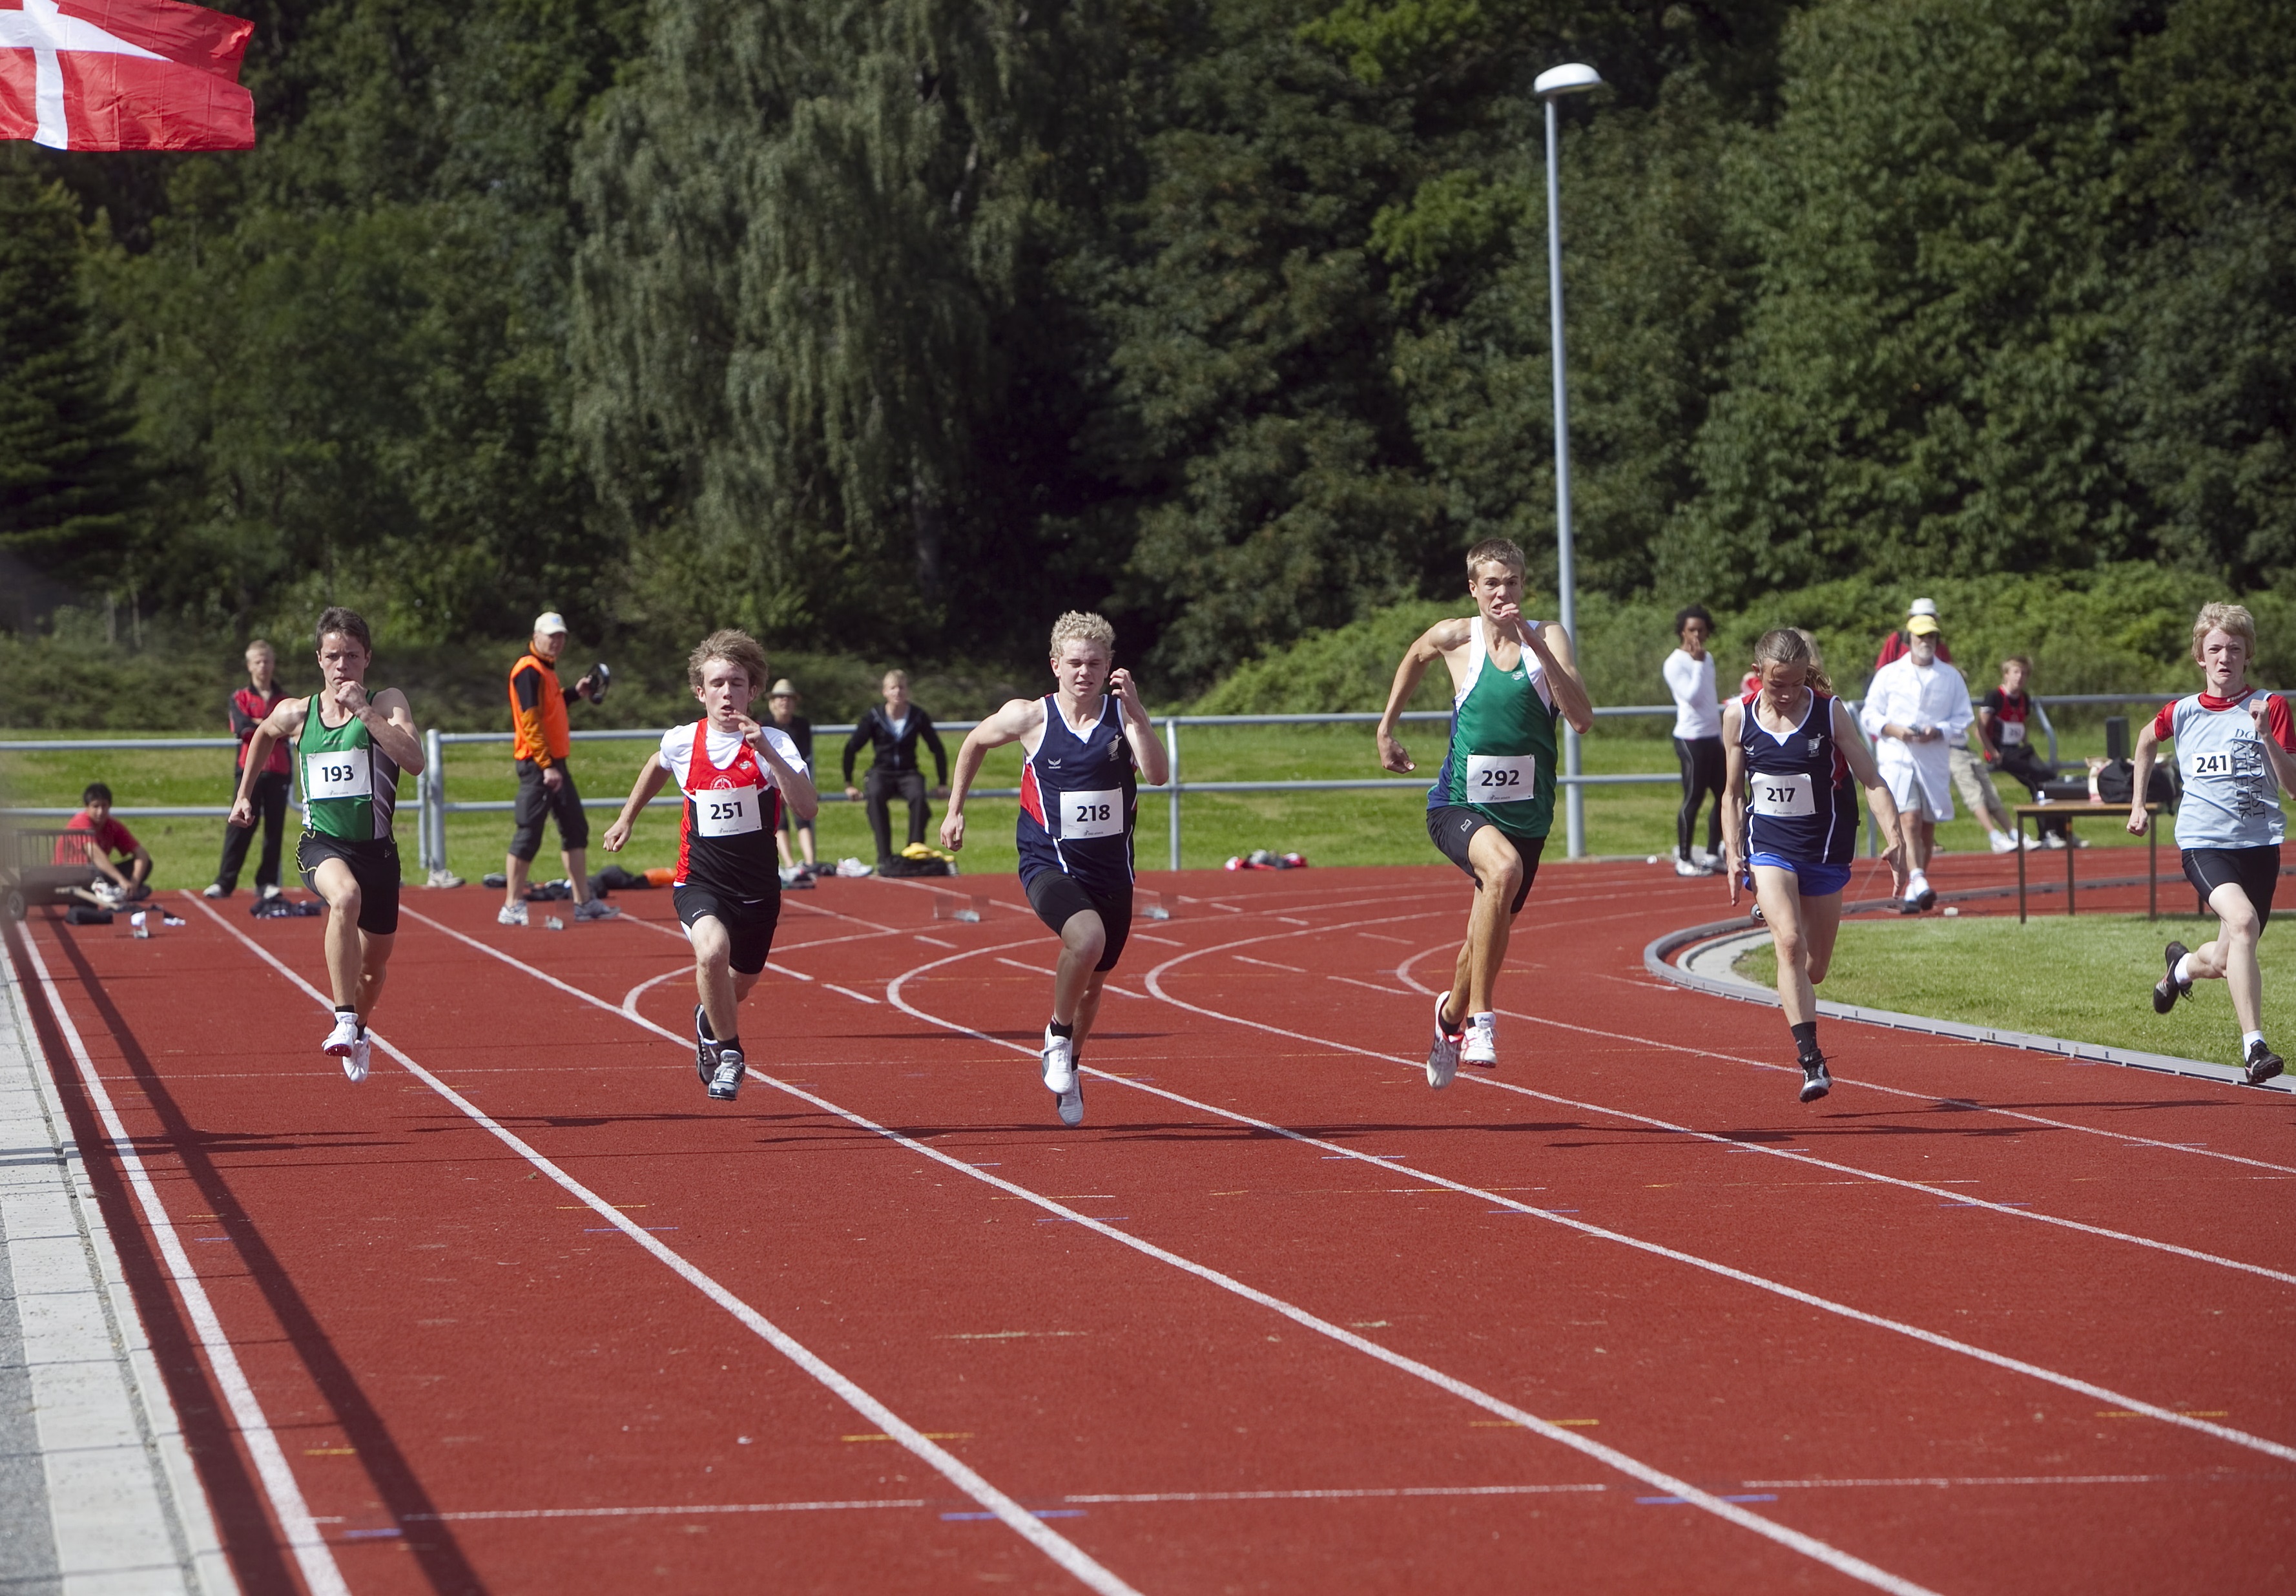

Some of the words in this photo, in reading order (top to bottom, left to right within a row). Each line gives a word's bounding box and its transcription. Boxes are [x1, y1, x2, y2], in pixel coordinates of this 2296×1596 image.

[2197, 755, 2227, 773] 241
[322, 765, 354, 782] 193
[1481, 769, 1520, 786] 292
[1766, 787, 1795, 802] 217
[710, 802, 743, 820] 251
[1077, 804, 1110, 822] 218
